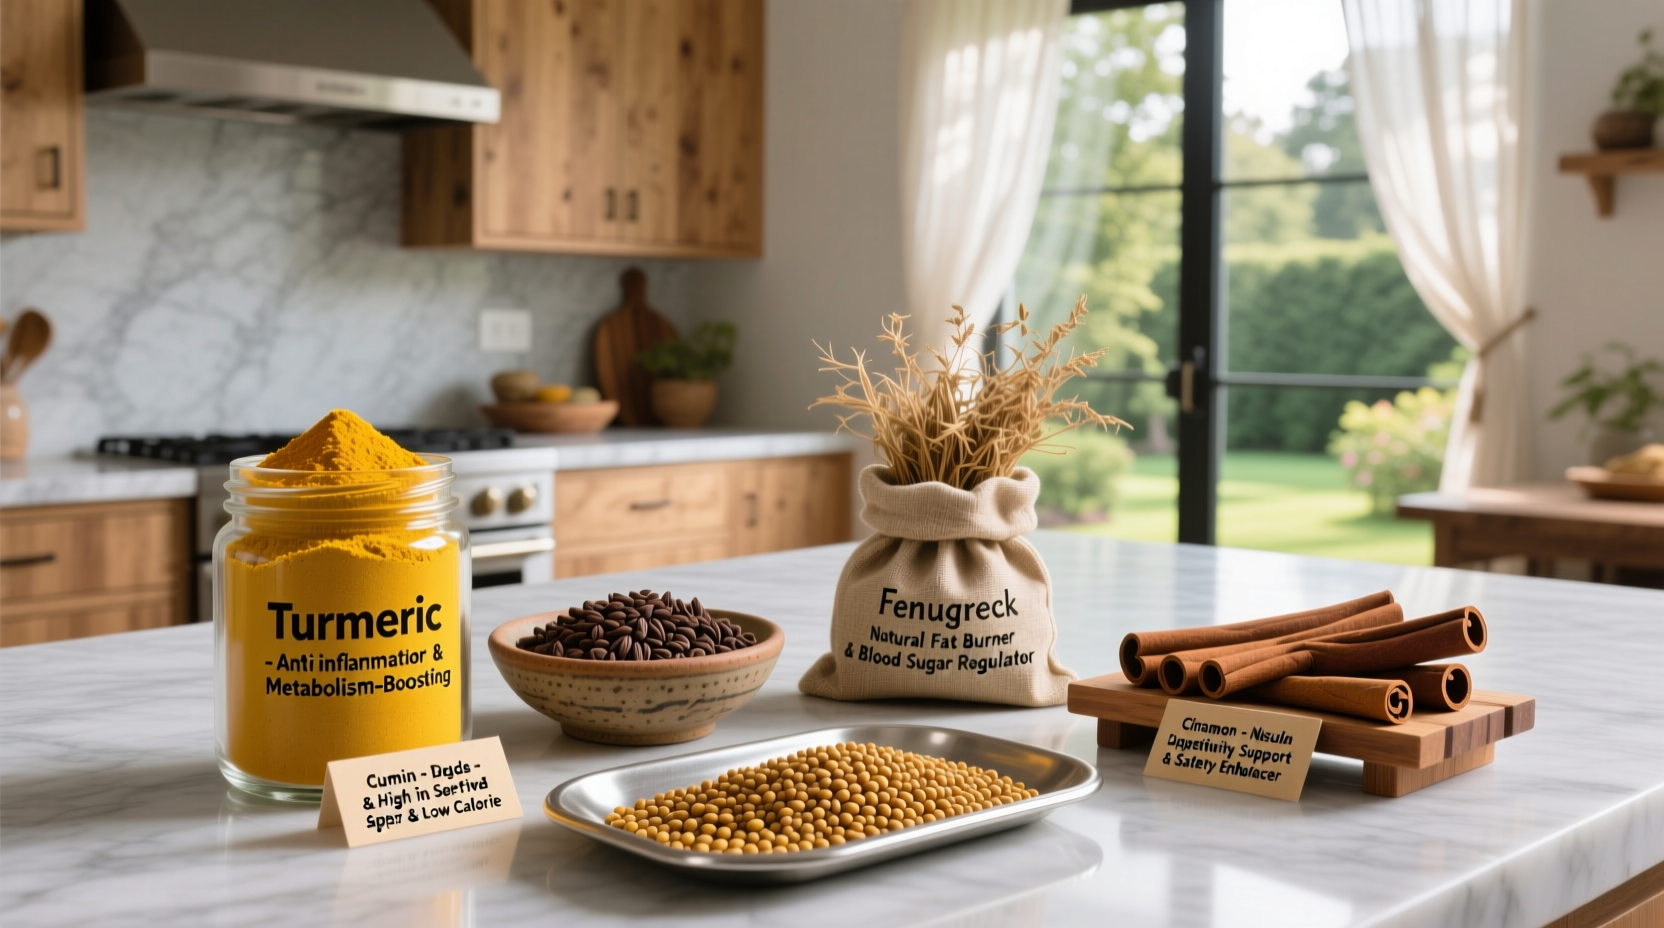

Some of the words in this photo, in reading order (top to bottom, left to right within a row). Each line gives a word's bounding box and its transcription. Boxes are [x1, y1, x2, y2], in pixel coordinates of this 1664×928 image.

[267, 595, 442, 641] Turmeric
[879, 587, 1018, 629] Fenugreck
[870, 625, 925, 648] Natural
[931, 633, 957, 649] Fat
[963, 632, 1015, 648] Burner
[277, 653, 314, 672] Anti
[433, 644, 443, 661] &
[844, 642, 854, 658] &
[859, 645, 901, 667] Blood
[906, 653, 953, 675] Sugar
[958, 650, 1035, 674] Regulator
[266, 668, 451, 696] Metabolism-Boosting
[1162, 752, 1171, 764] &
[1239, 744, 1292, 764] Support
[367, 769, 416, 788] Cumin
[363, 797, 375, 810] &
[378, 788, 411, 809] High
[416, 787, 430, 801] in
[408, 808, 419, 822] &
[422, 804, 450, 819] Low
[454, 794, 501, 813] Calorie
